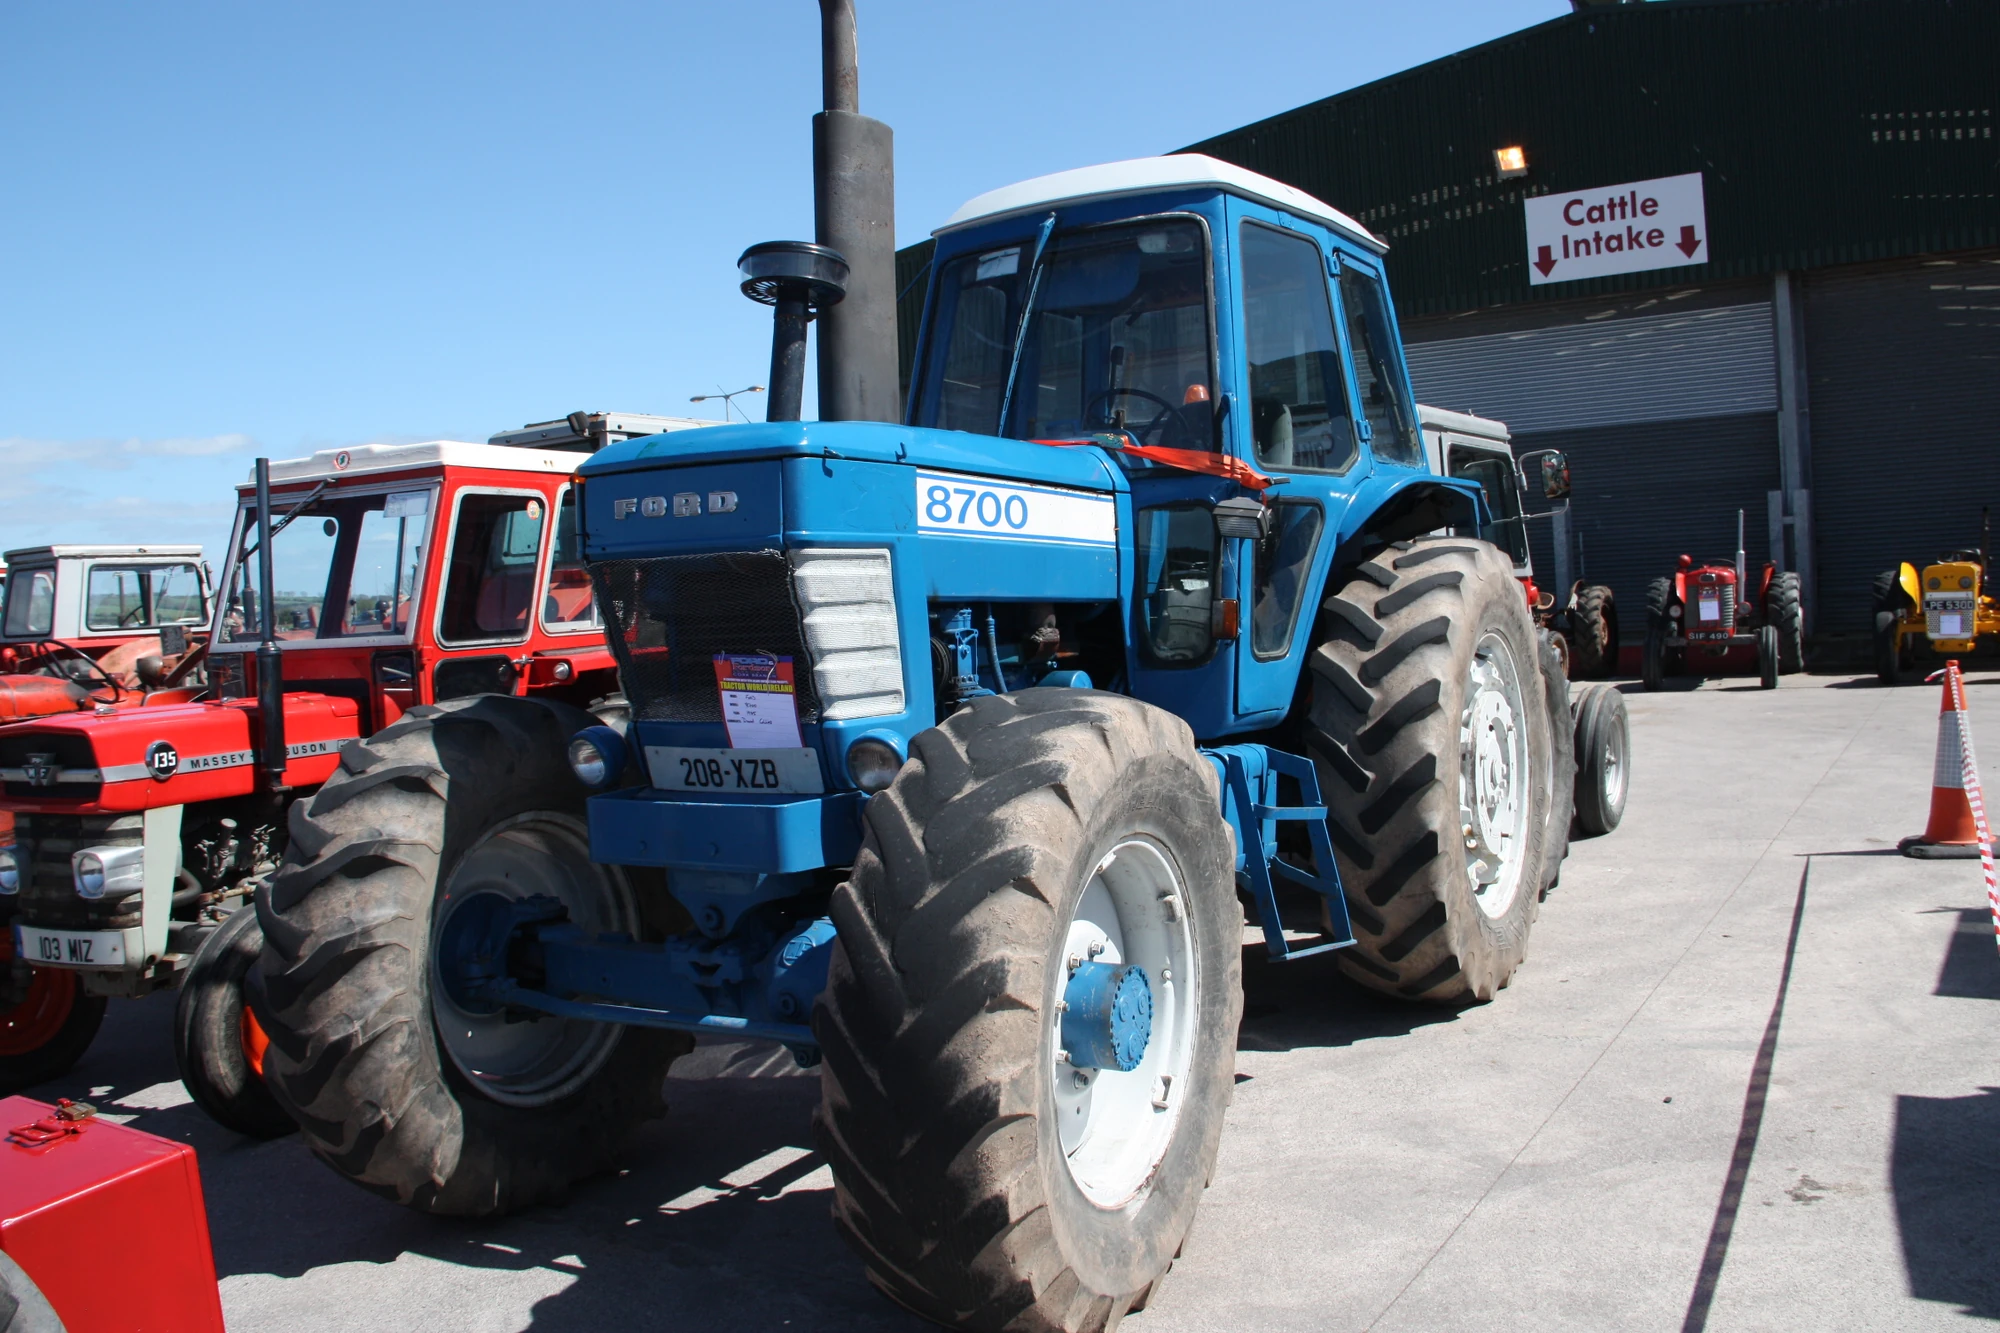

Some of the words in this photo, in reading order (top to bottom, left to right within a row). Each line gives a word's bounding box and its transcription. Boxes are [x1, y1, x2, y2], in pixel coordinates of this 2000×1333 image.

[1563, 190, 1659, 227] Cattle
[1562, 225, 1665, 260] Intake
[614, 491, 739, 520] FORD
[925, 485, 1029, 530] 8700
[1688, 632, 1706, 640] SIF
[1709, 632, 1729, 640] 490
[721, 682, 746, 690] TRACTOR
[747, 683, 768, 691] WORLD
[769, 684, 793, 692] IRELAND
[153, 751, 177, 768] 135
[190, 753, 246, 769] MASSEY
[679, 757, 780, 789] 208-XZB
[38, 936, 62, 960] 103
[67, 939, 95, 963] MIZ
